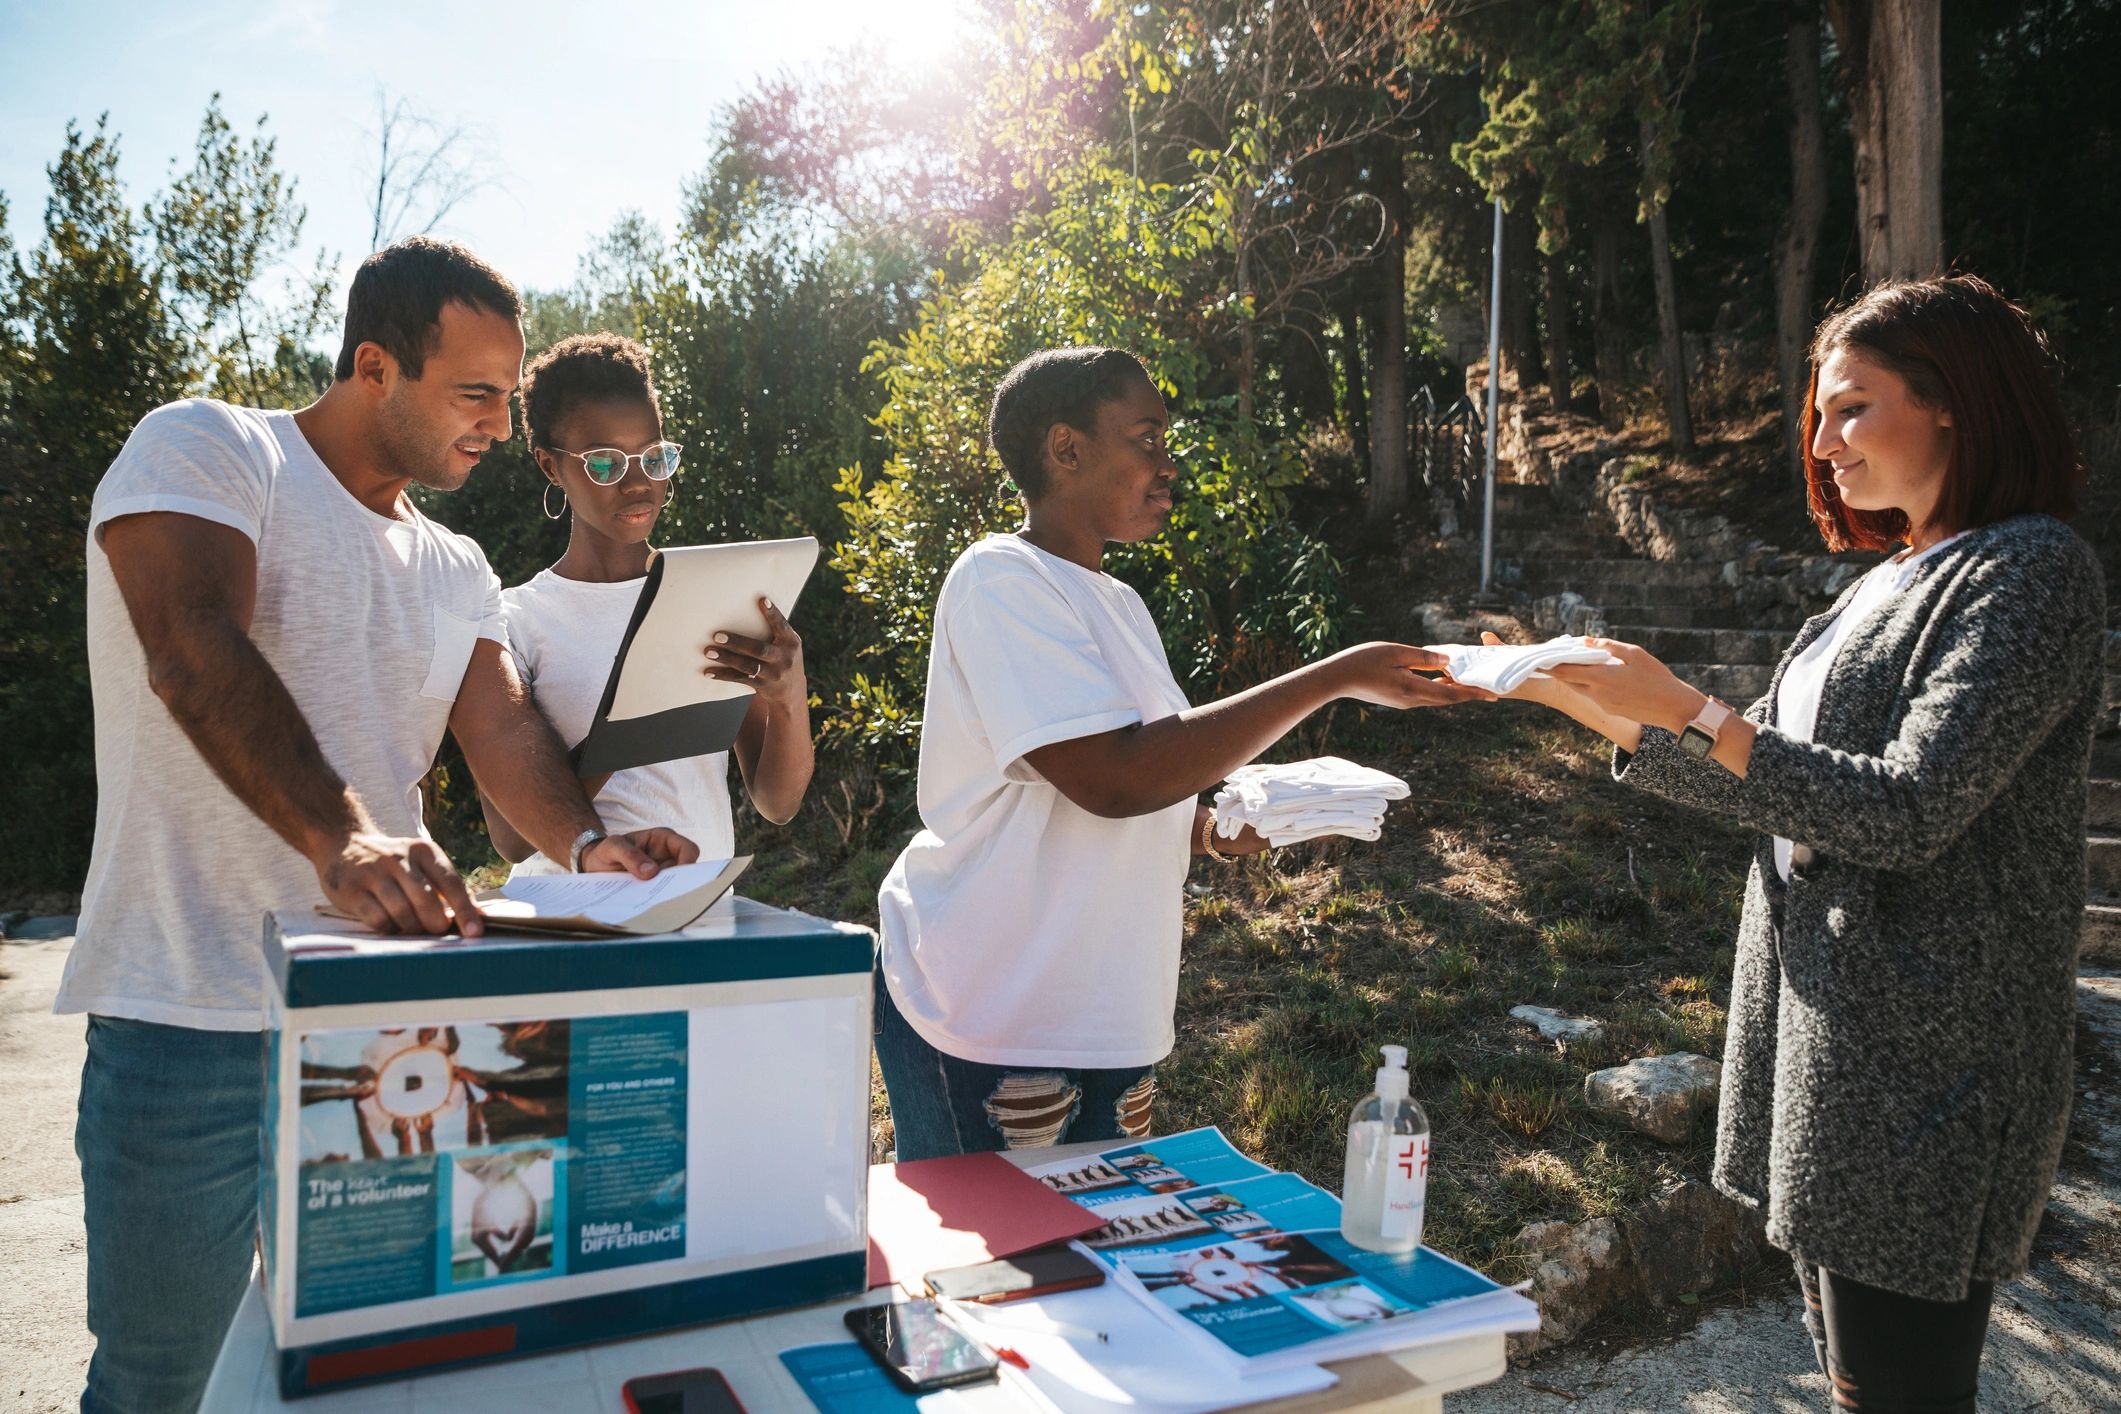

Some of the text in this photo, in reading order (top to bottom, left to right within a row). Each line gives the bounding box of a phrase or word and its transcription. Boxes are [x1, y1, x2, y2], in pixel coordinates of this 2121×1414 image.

[586, 1077, 675, 1092] FOR YOU AND OTHERS
[308, 1179, 344, 1195] The
[307, 1183, 431, 1210] of a volunteer
[581, 1221, 633, 1238] Make a
[581, 1225, 680, 1254] DIFFERENCE
